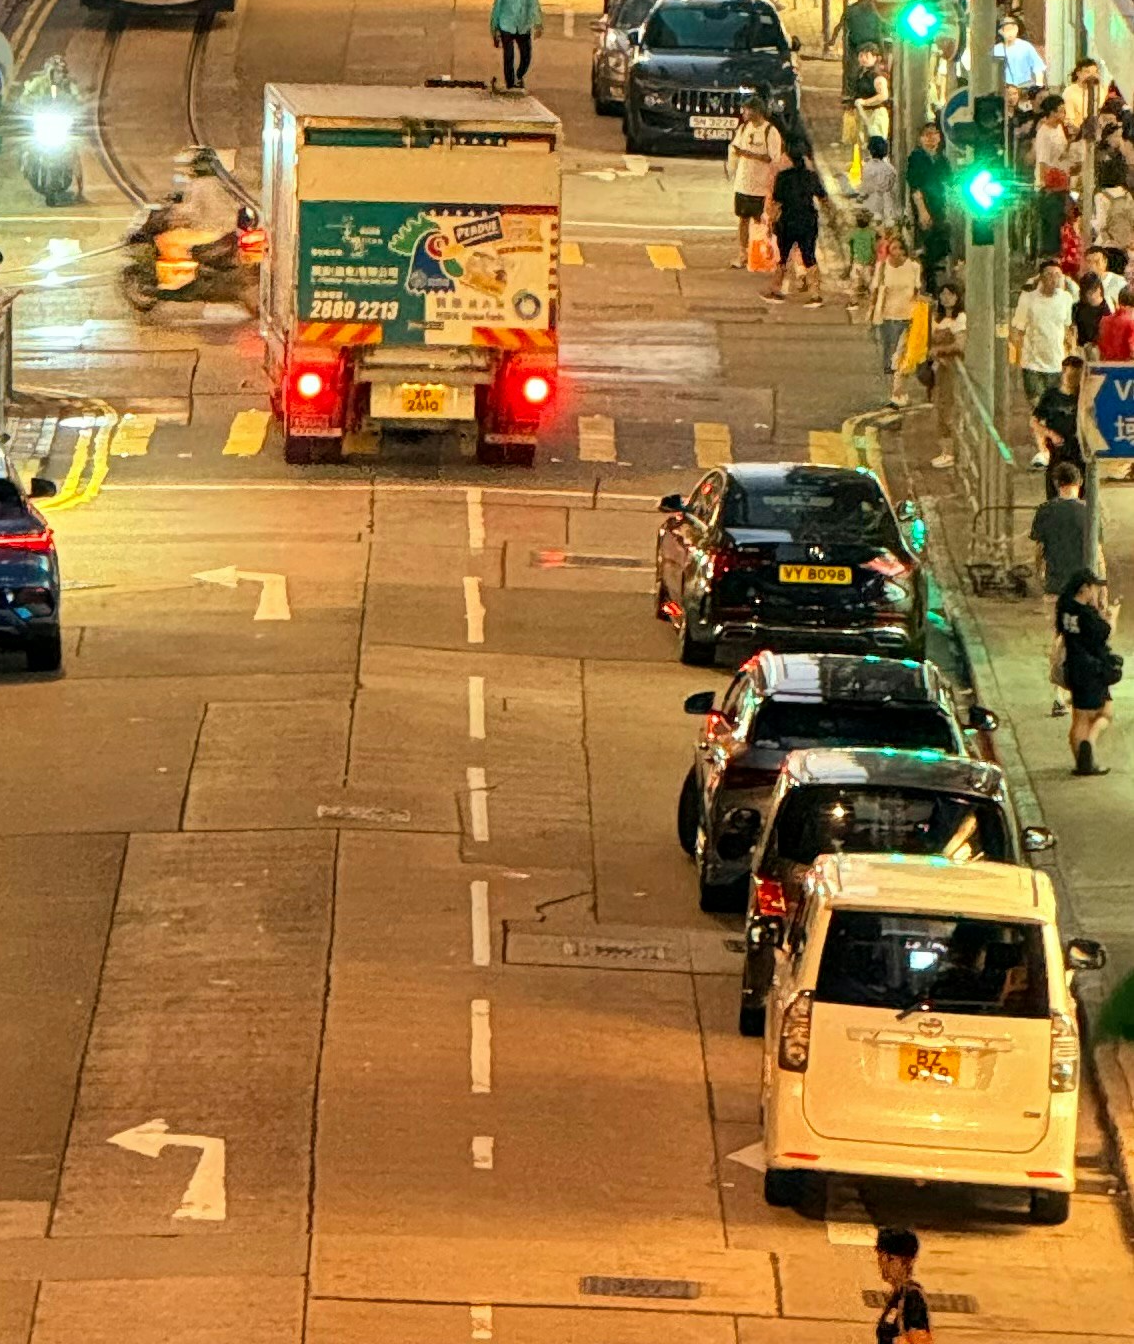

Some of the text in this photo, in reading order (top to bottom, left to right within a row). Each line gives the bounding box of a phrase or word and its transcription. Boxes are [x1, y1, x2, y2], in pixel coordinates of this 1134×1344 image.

[1114, 379, 1134, 401] V
[783, 567, 847, 581] VY 8098
[916, 1049, 941, 1066] BZ
